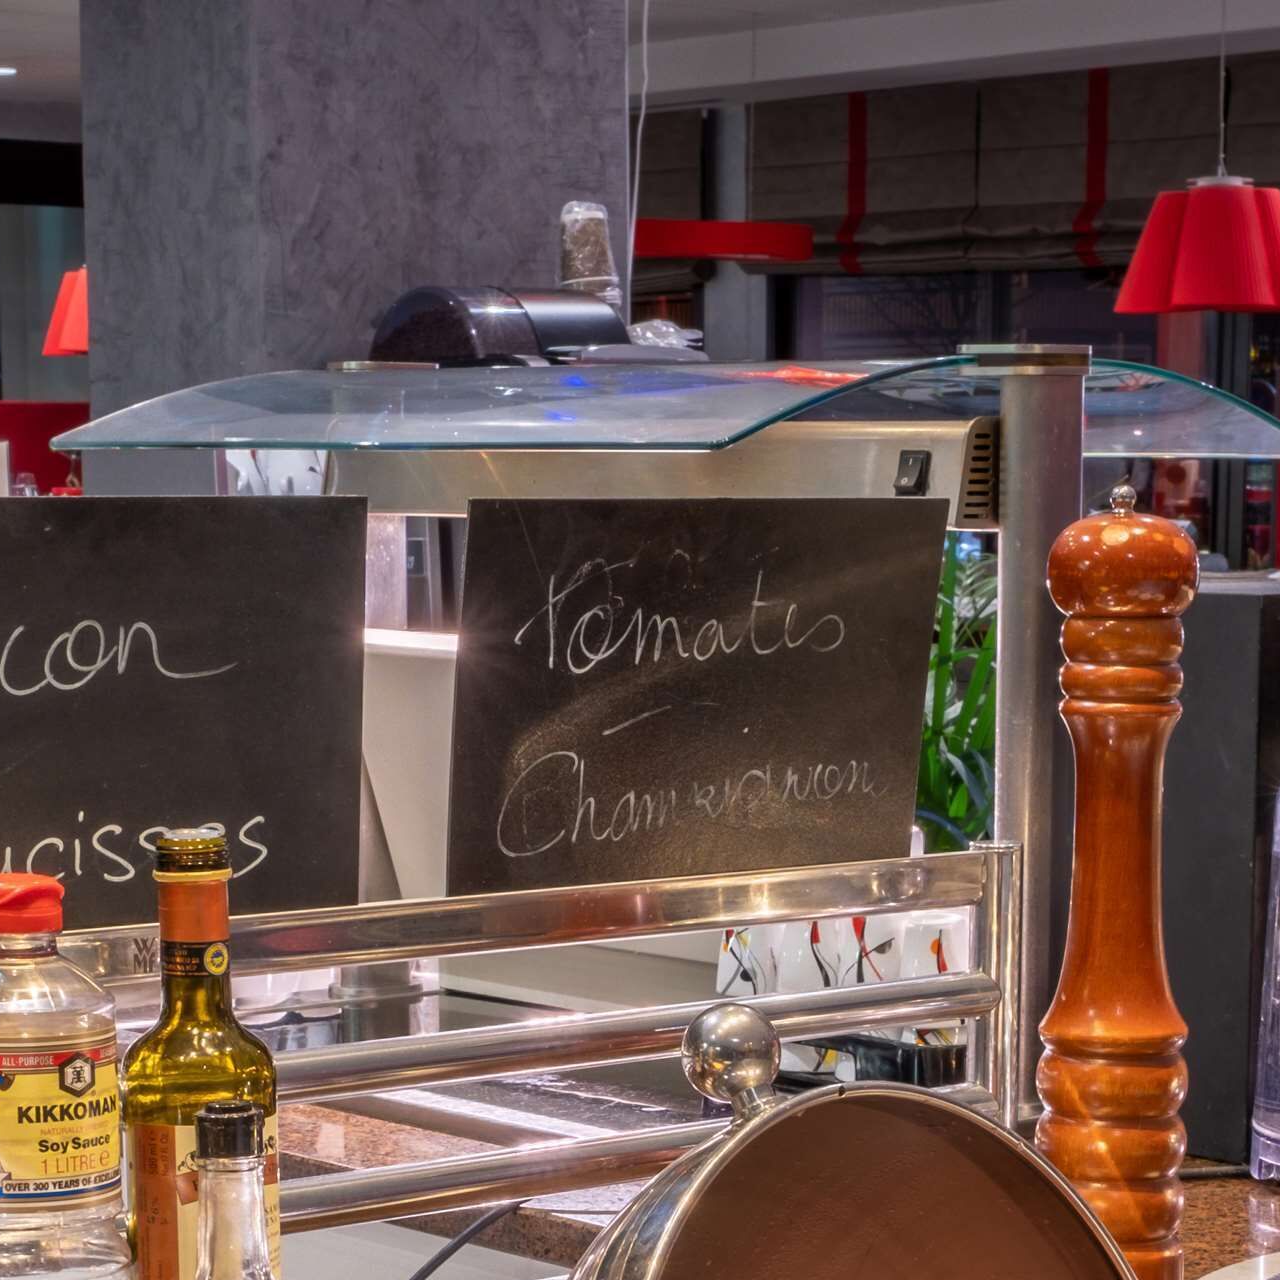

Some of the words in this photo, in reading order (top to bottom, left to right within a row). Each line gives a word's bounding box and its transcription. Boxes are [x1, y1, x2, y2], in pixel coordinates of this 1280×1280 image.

[1, 1055, 55, 1067] ALL-PURPOSE
[17, 1094, 117, 1125] KIKKOMAN
[38, 1139, 70, 1154] Soy
[71, 1133, 111, 1150] Sauce
[41, 1160, 48, 1175] 1
[55, 1154, 96, 1174] LITRE
[4, 1182, 30, 1192] OVER
[32, 1182, 49, 1191] 300
[51, 1179, 80, 1190] YEARS
